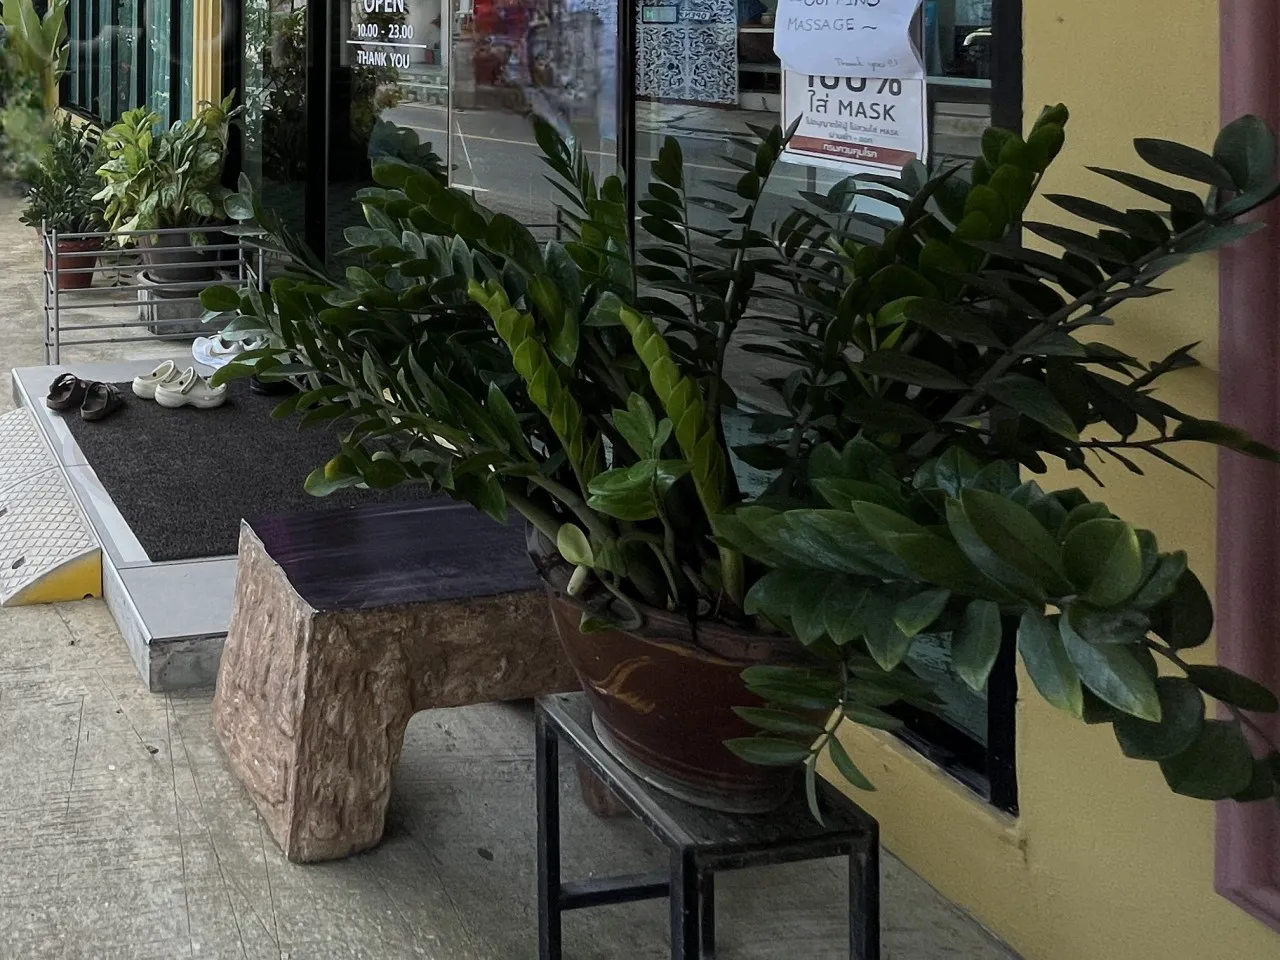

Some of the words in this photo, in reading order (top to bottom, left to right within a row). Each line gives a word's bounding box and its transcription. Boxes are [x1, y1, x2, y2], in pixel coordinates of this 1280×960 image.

[357, 23, 378, 38] 10.00
[388, 24, 413, 39] 23.00
[357, 50, 387, 66] THANK
[389, 53, 410, 69] YOU
[808, 89, 829, 114] ใส่
[838, 99, 896, 122] MASK
[879, 128, 899, 137] MASK
